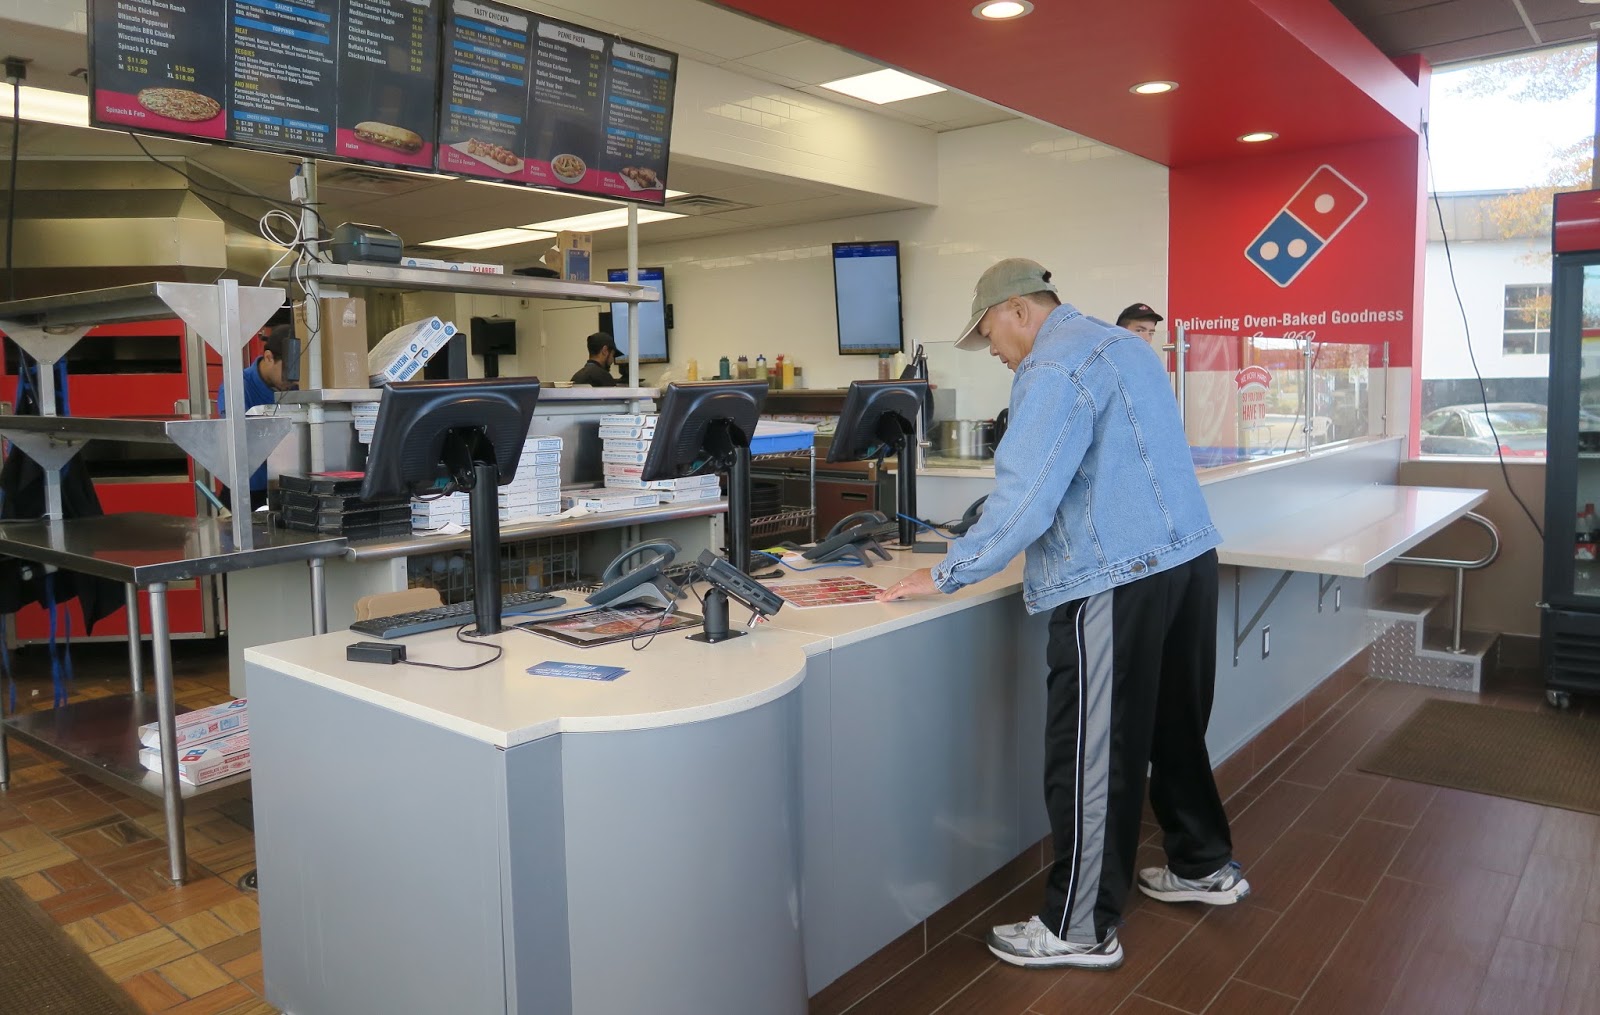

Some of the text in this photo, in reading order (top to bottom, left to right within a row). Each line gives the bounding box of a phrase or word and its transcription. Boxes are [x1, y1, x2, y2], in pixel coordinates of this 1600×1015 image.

[117, 2, 159, 16] Buffalo Chicken
[152, 0, 168, 9] Bacon
[169, 3, 185, 12] Ranch
[117, 12, 168, 29] Ultimate Pepperoni
[349, 17, 362, 25] Italian
[473, 7, 509, 22] TASTY CHICKEN
[117, 22, 175, 39] Memphis BBQ Chicken
[235, 26, 247, 34] MEAT
[272, 25, 294, 35] TOPPINGS
[348, 25, 394, 41] Chicken Bacon Ranch
[557, 30, 585, 43] PENNE PASTA
[118, 32, 144, 43] Wisconsin
[150, 38, 168, 48] Cheese
[348, 34, 365, 43] Chicken
[118, 42, 138, 52] Spinach
[145, 47, 157, 55] Feta
[235, 47, 254, 56] VEGGIES
[348, 43, 381, 55] Buffalo Chicken
[537, 49, 547, 57] Pasta
[347, 51, 386, 64] Chicken Habanero
[537, 59, 551, 68] Chicken
[644, 54, 655, 62] SIDES
[106, 105, 127, 114] Spinach
[1175, 309, 1404, 331] Delivering Oven-Baked Goodness
[390, 355, 409, 375] MEDIUM
[399, 360, 419, 380] MEDIUM
[1242, 393, 1247, 402] SO
[1243, 404, 1265, 420] HAVE TO
